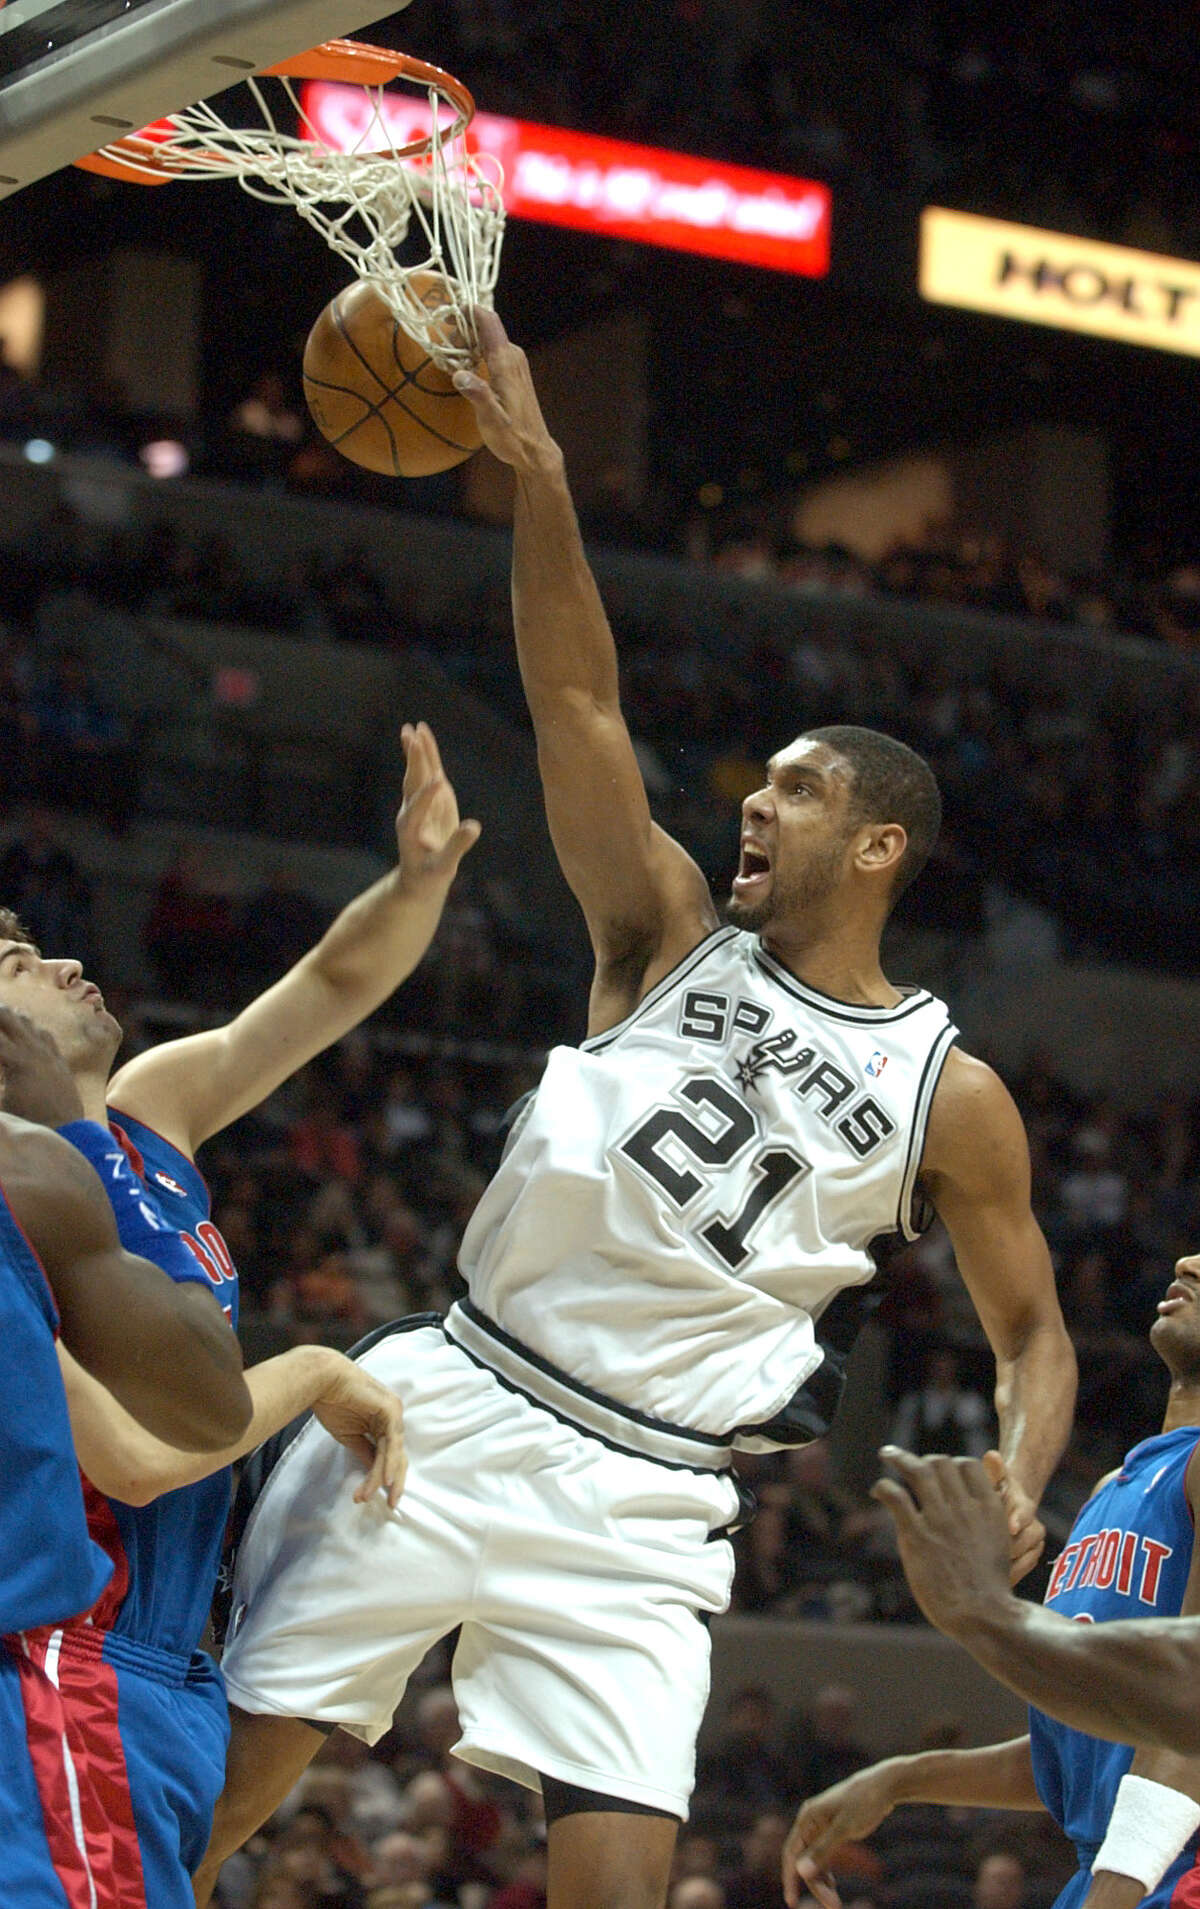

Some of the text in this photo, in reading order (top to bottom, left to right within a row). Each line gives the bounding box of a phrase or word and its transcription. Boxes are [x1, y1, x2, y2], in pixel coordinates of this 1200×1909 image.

[998, 251, 1199, 323] HOLT
[677, 989, 897, 1161] SPURS
[607, 1072, 813, 1276] 21
[1043, 1528, 1173, 1607] ETROIT
